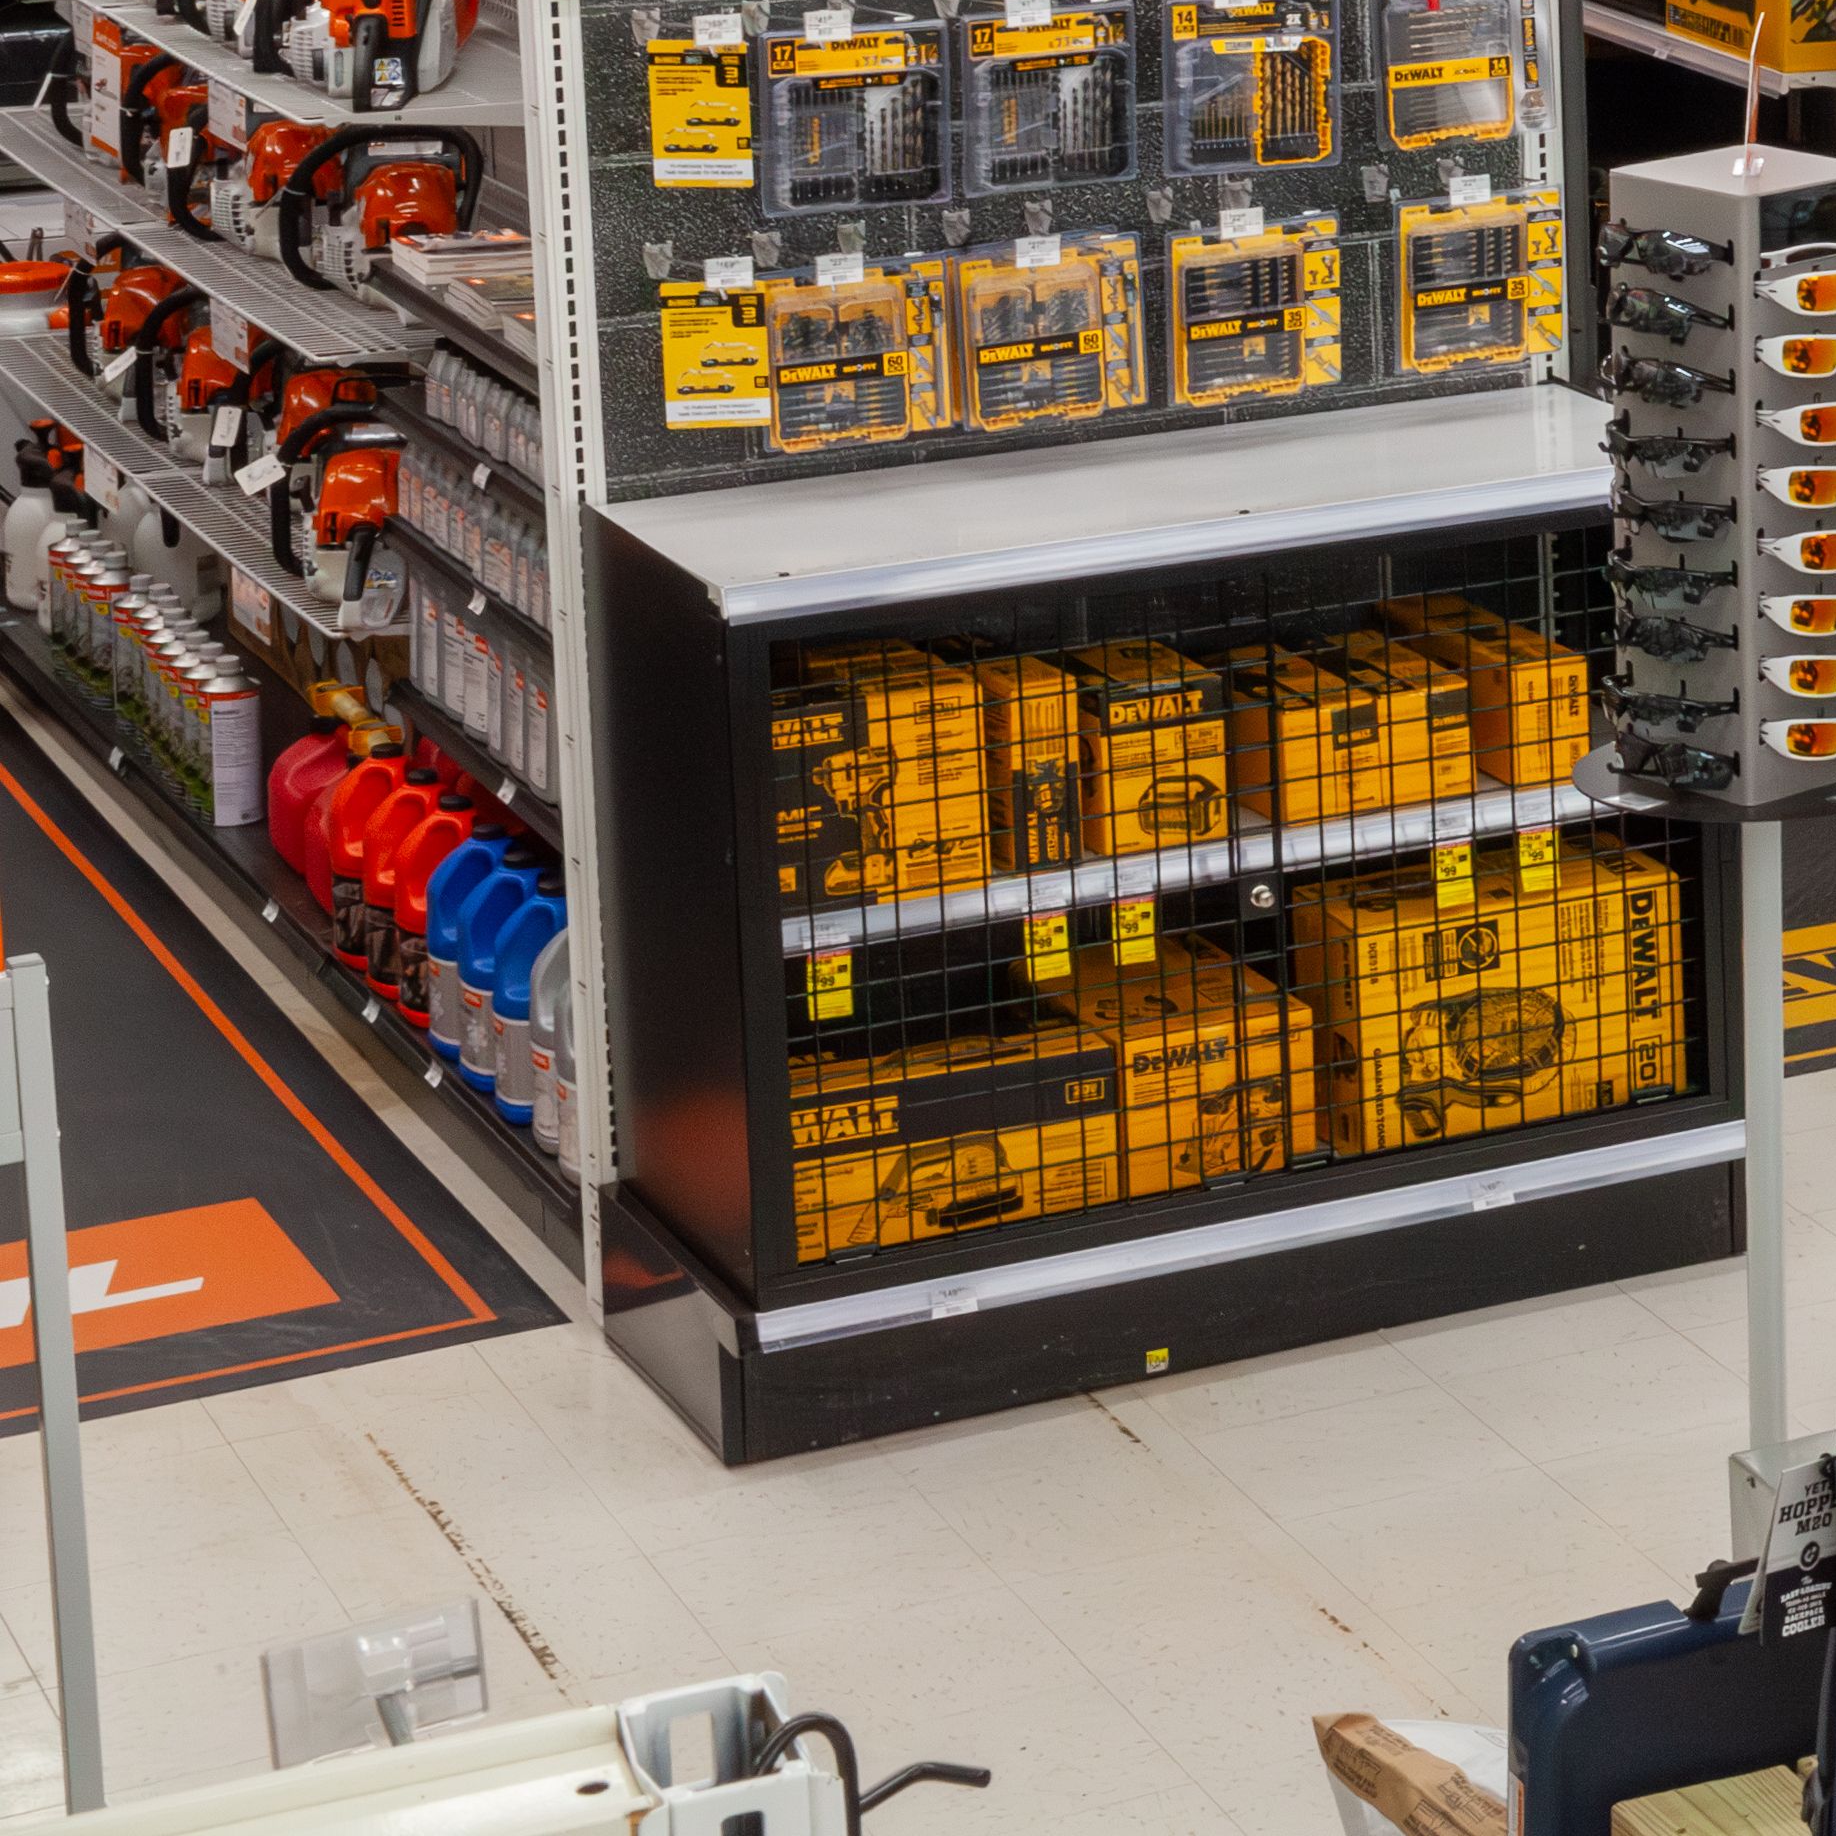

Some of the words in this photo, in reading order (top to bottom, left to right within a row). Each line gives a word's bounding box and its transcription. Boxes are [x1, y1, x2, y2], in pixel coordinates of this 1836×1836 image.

[1176, 11, 1193, 25] 14
[974, 28, 993, 44] 17
[774, 47, 792, 61] 17
[1394, 68, 1444, 81] DEWALT
[1084, 334, 1099, 346] 60
[887, 356, 904, 368] 60
[1630, 892, 1658, 1021] DEWALT
[1795, 1513, 1832, 1536] M20
[1782, 1615, 1825, 1637] COOLER
